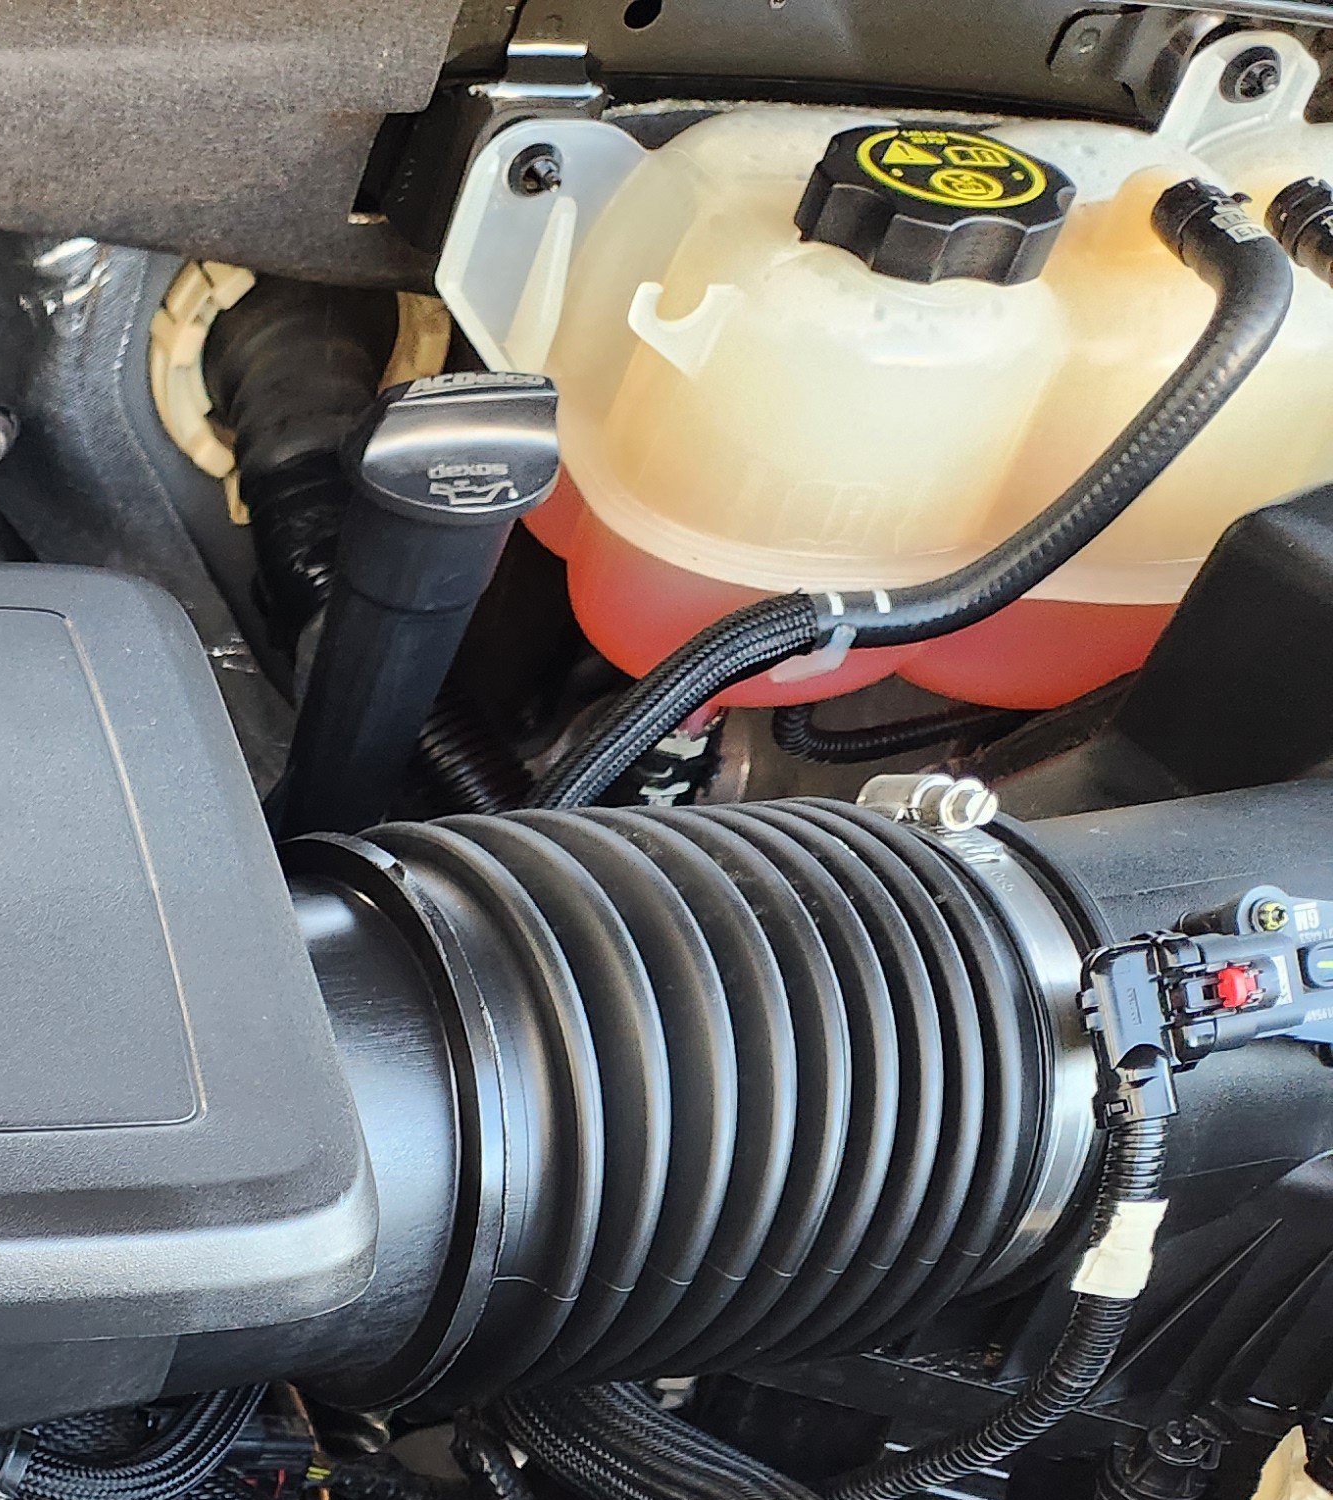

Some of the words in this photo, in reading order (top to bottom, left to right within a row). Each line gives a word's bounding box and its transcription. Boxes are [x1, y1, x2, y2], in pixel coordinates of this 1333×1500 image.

[407, 371, 546, 394] ACDelco
[428, 463, 509, 479] dexos
[1294, 909, 1320, 931] GM
